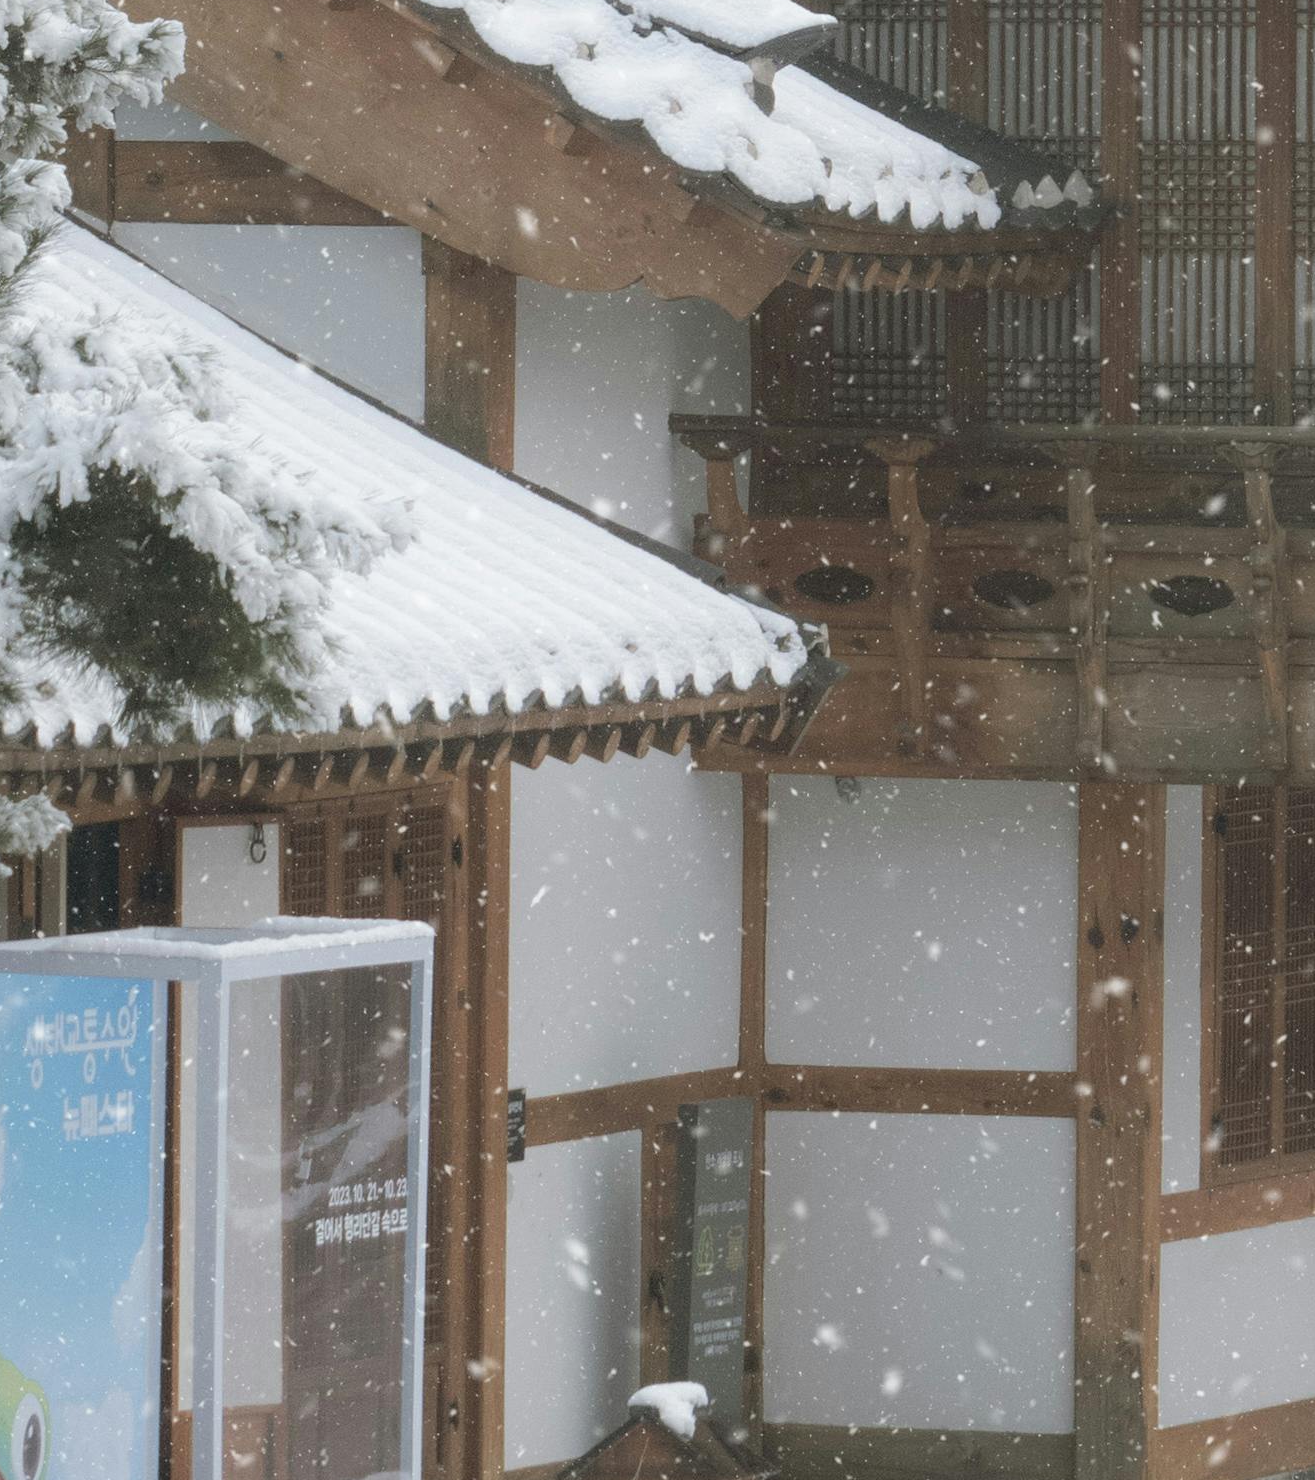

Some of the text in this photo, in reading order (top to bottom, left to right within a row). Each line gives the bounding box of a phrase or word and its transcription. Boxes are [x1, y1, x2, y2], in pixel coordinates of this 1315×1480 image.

[315, 1207, 409, 1245] 걸어서 행리단길 속으로
